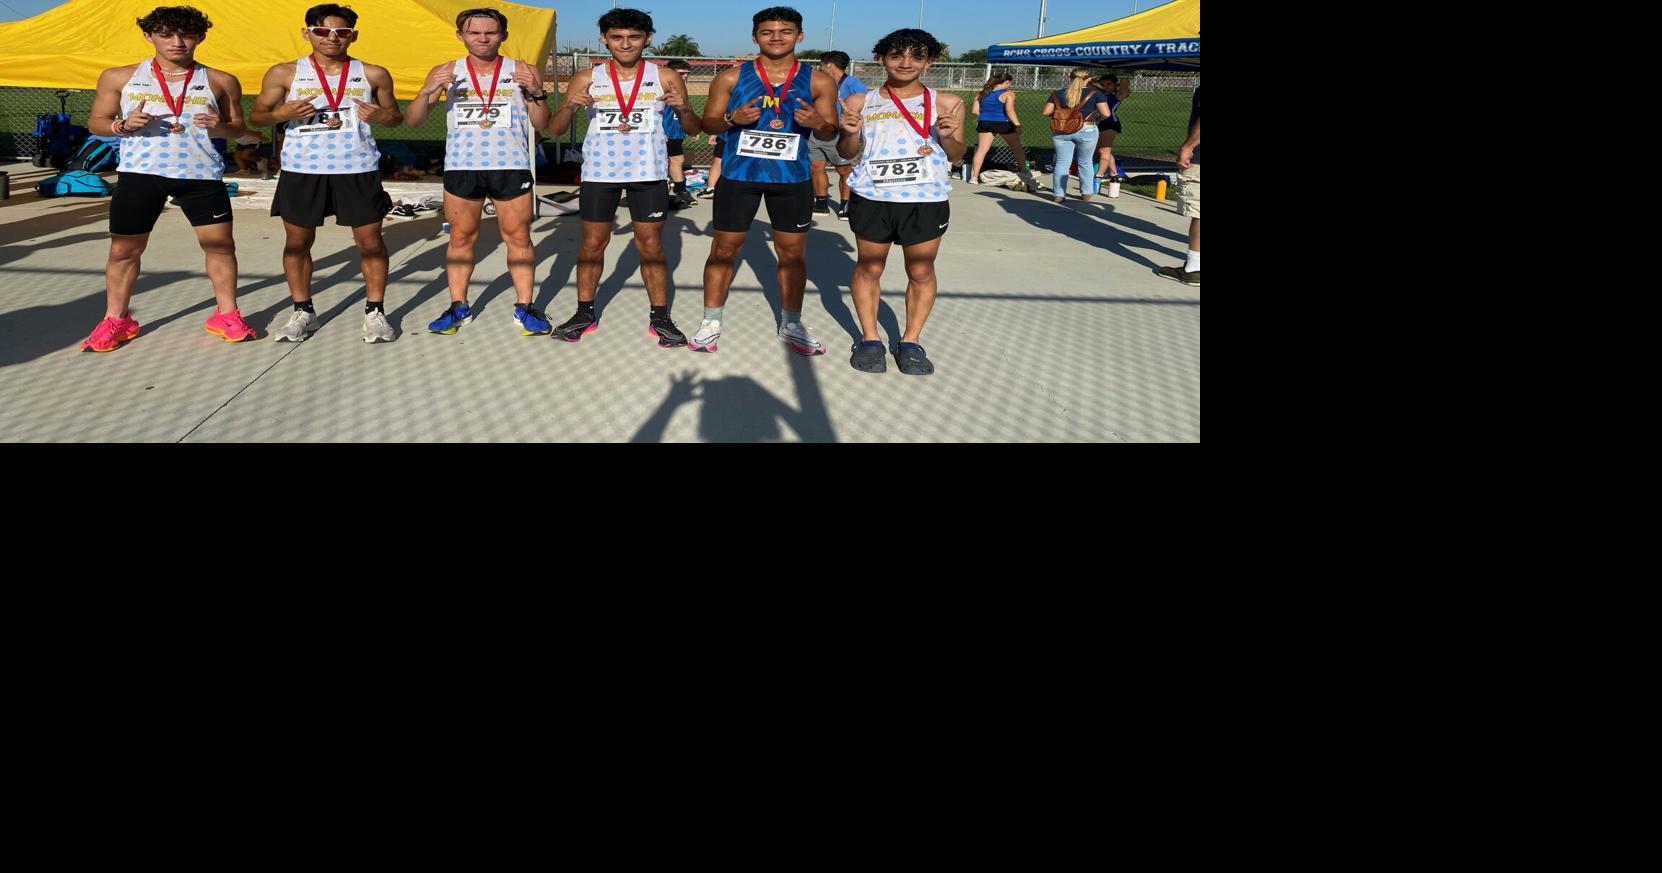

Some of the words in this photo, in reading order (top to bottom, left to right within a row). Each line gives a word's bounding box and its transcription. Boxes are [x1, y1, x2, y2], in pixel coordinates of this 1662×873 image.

[1033, 44, 1142, 57] CROSS-COUNTRY
[1155, 41, 1200, 54] TRAC
[128, 92, 208, 105] MONCHE
[762, 95, 780, 108] M
[463, 108, 500, 118] 779
[606, 112, 643, 124] 768
[749, 136, 787, 150] 786
[876, 162, 920, 177] 782
